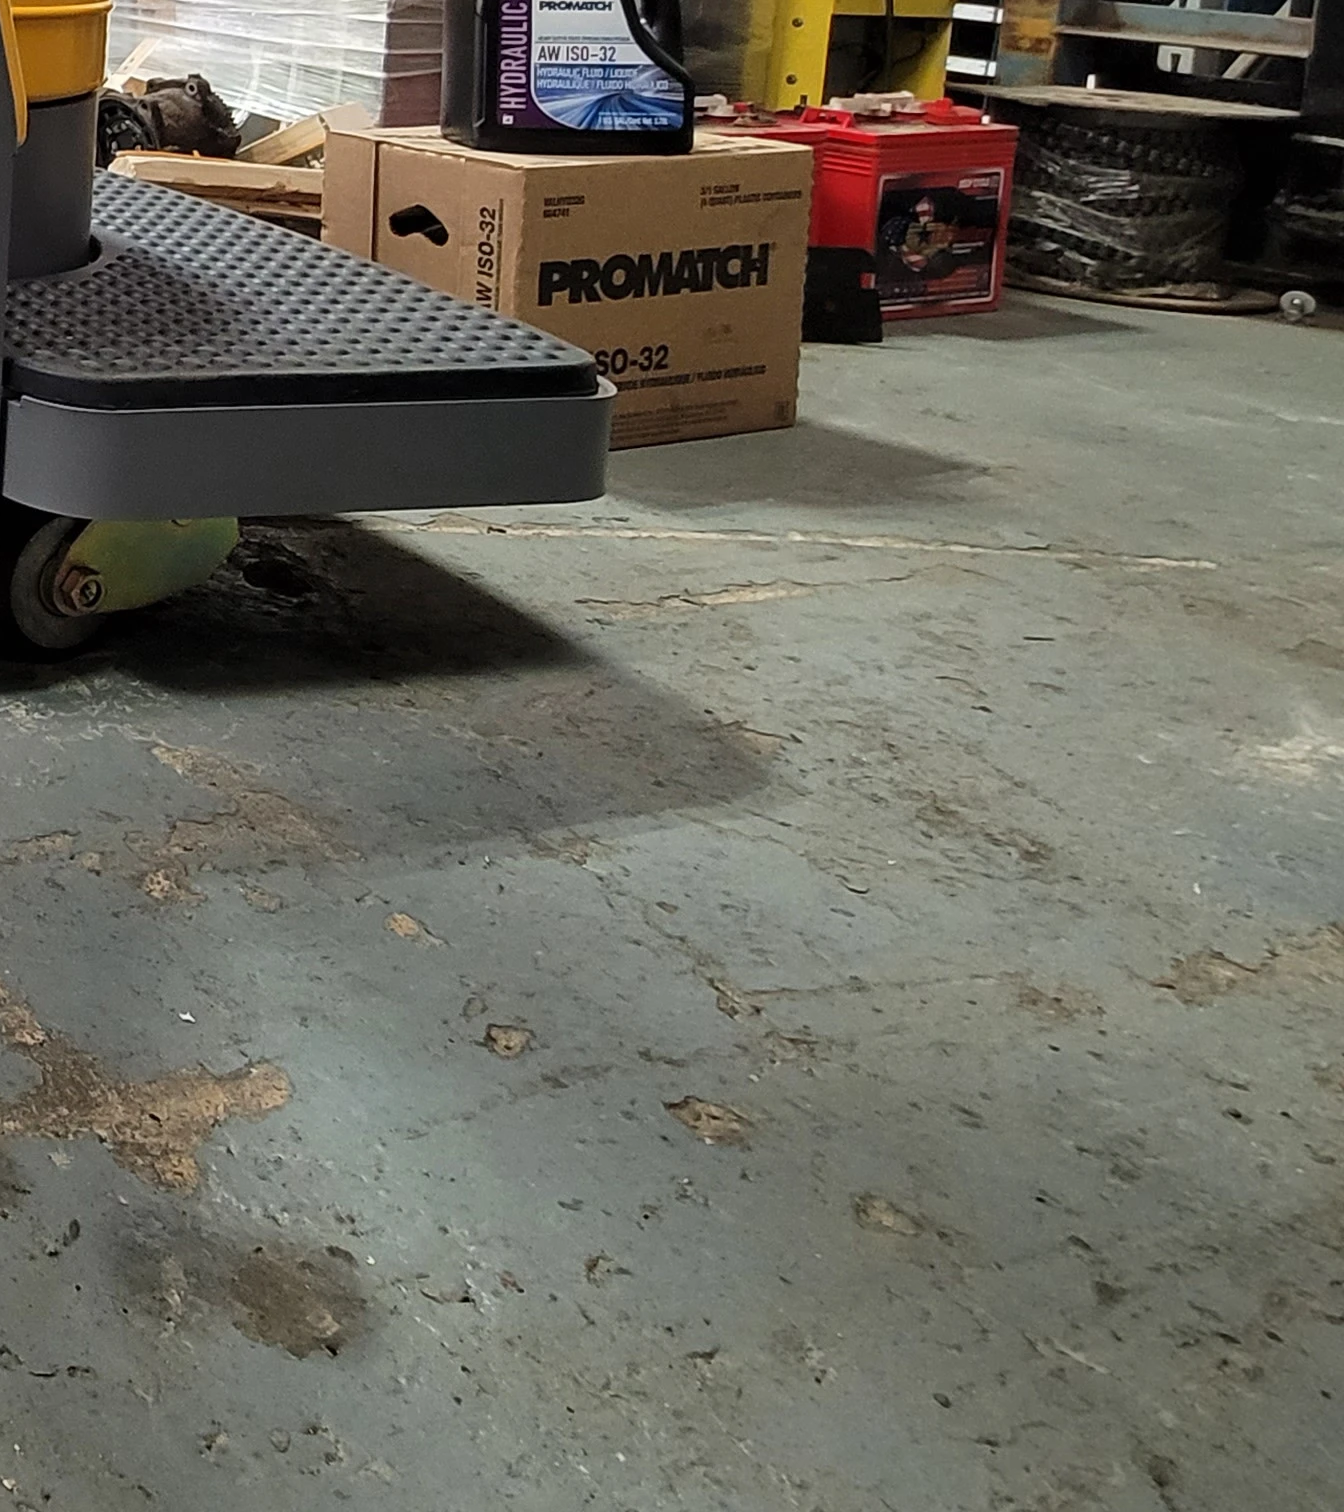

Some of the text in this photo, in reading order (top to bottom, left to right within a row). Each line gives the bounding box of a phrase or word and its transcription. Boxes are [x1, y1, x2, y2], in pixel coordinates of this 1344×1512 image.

[539, 0, 613, 11] PROMATCH
[500, 2, 528, 109] HYDRAULIC
[537, 46, 617, 62] AW ISO-32
[476, 206, 496, 279] ISO-32
[537, 242, 770, 307] PROMATCH
[593, 344, 669, 376] SO-32
